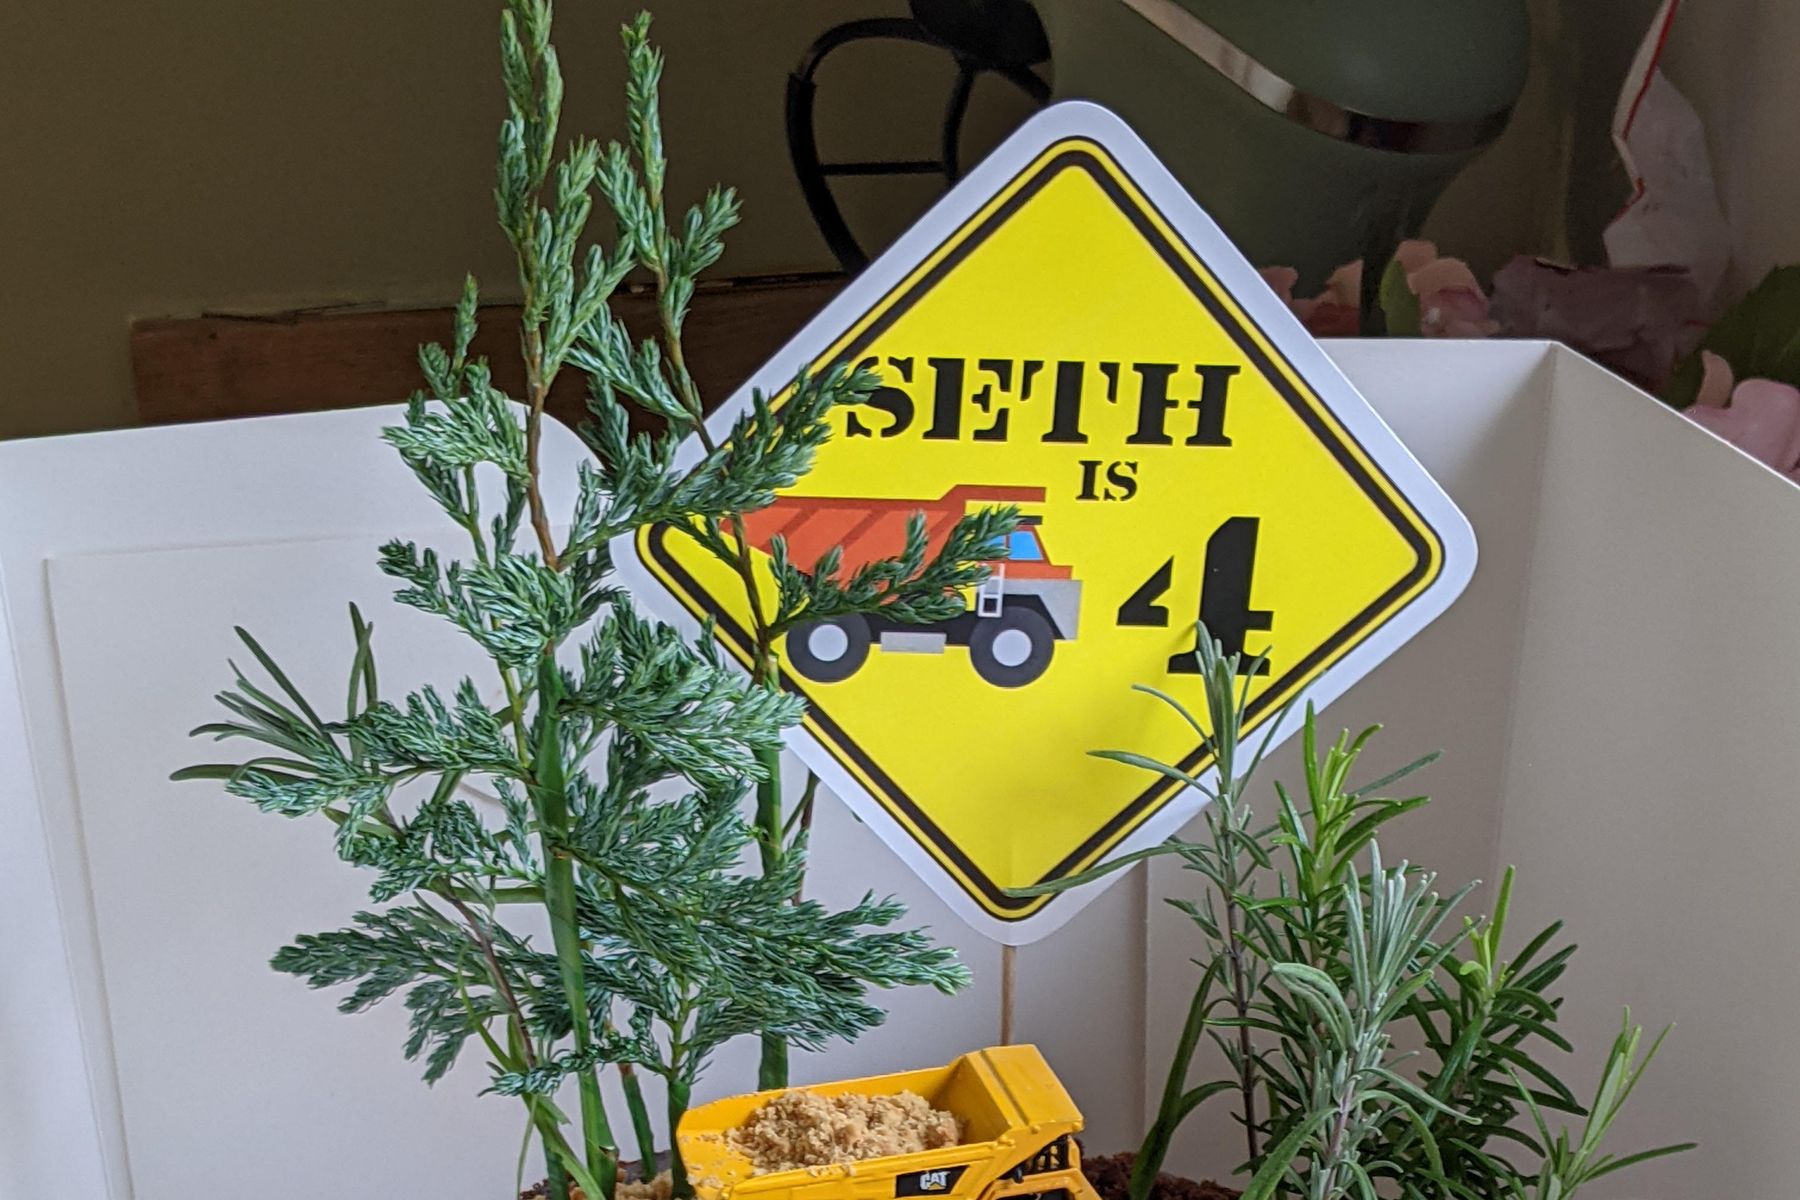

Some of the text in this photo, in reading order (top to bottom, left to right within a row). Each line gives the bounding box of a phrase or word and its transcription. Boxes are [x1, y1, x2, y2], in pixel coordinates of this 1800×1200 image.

[846, 355, 1241, 446] SETH
[1076, 460, 1139, 501] IS
[1117, 516, 1274, 675] 4
[920, 1170, 951, 1190] CAT
